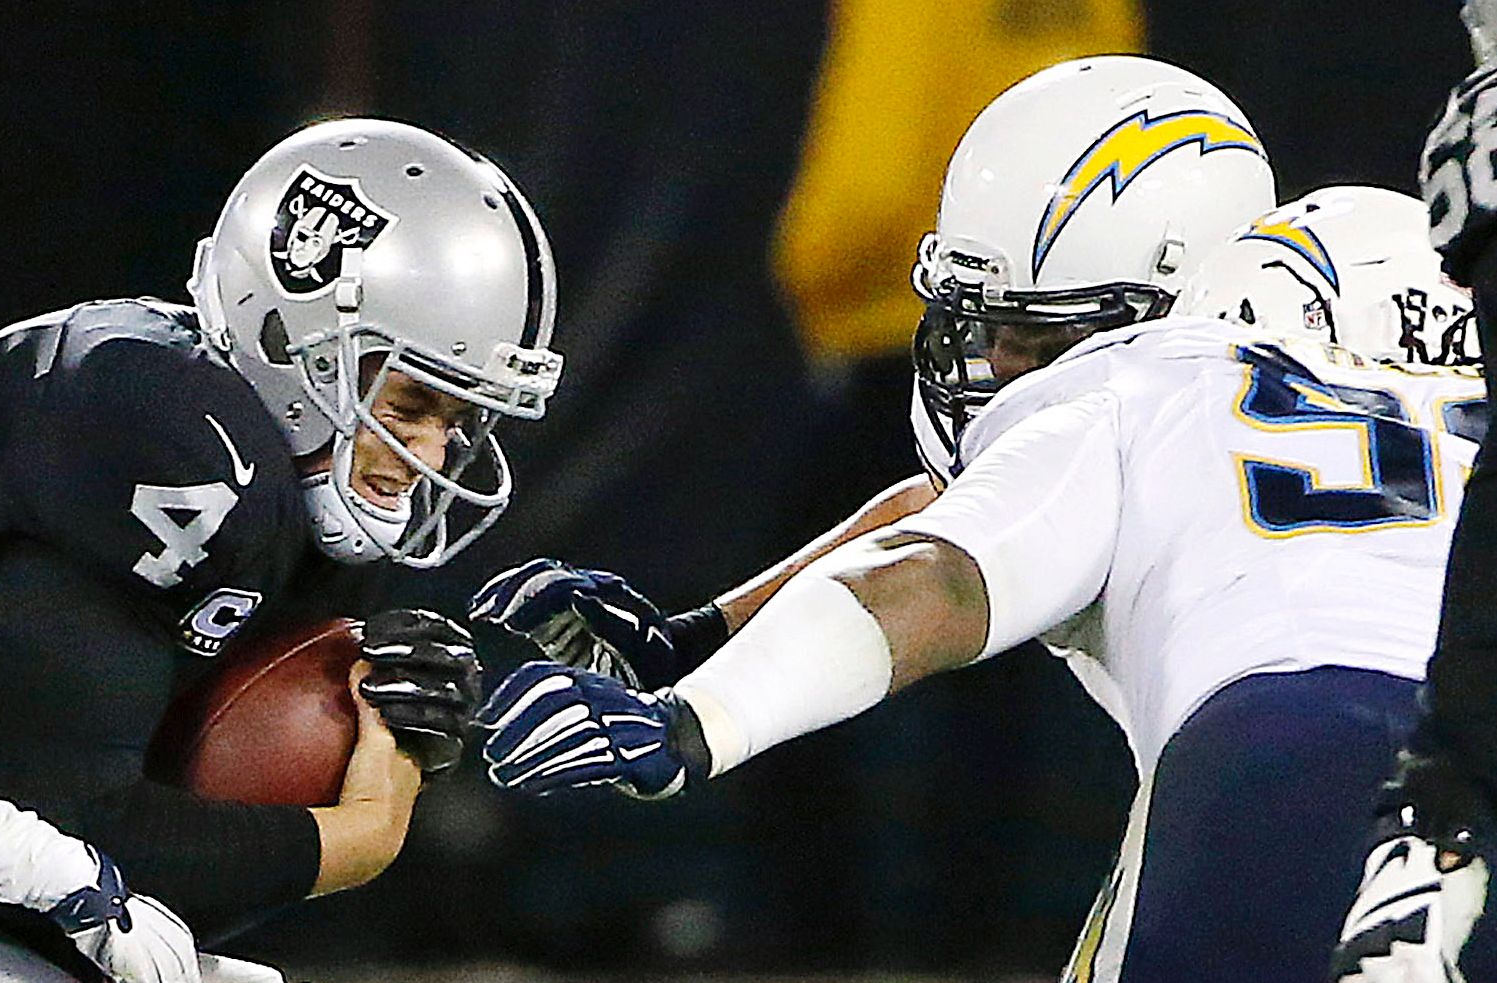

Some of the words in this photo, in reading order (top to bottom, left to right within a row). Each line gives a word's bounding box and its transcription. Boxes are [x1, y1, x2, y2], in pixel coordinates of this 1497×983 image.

[300, 176, 378, 228] RAIDERS
[132, 482, 239, 588] 4
[191, 595, 253, 638] C
